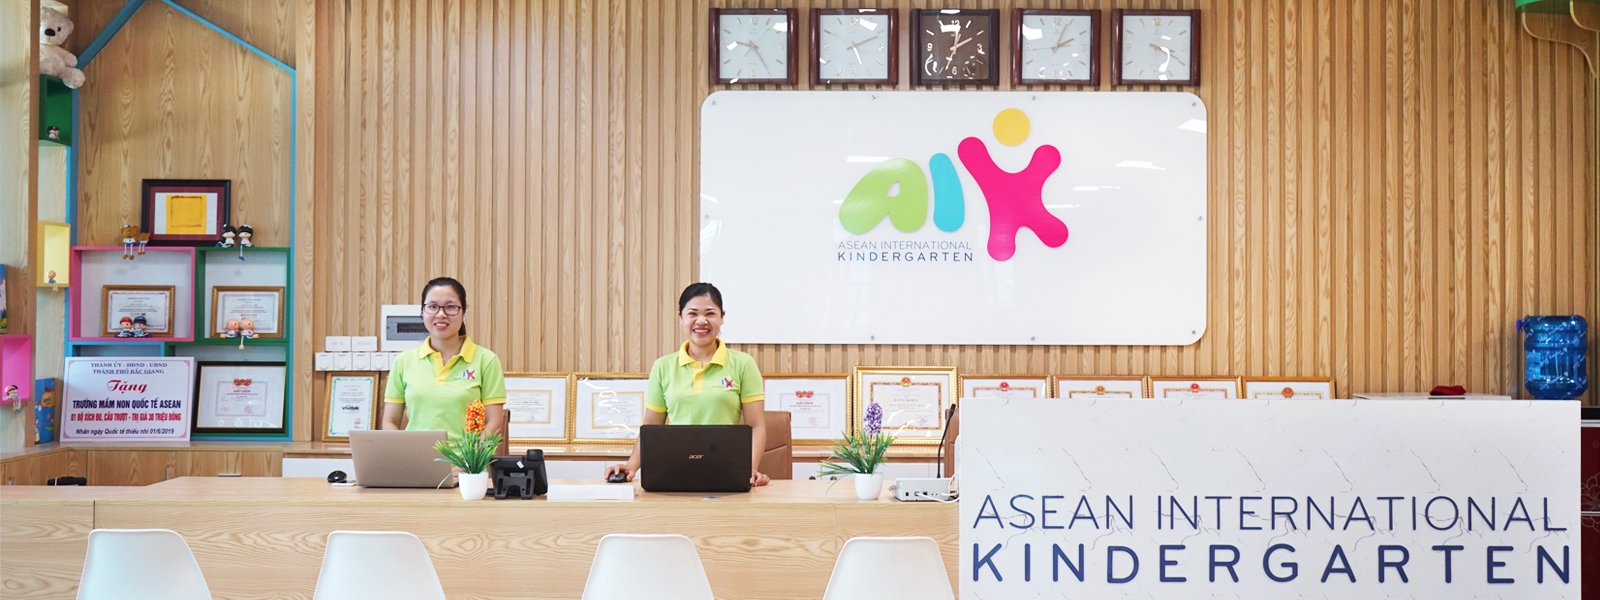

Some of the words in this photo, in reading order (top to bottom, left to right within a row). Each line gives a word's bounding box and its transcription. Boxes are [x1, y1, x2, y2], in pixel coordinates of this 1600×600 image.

[838, 241, 877, 250] ASEAN
[880, 241, 972, 250] INTERNATIONAL
[838, 252, 973, 262] KINDERGARTEN
[106, 380, 148, 394] Tặng
[116, 400, 130, 409] NON
[132, 397, 149, 410] QUỐC
[160, 400, 182, 409] ASEAN
[973, 494, 1133, 530] ASEAN
[1158, 495, 1567, 532] INTERNATIONAL
[972, 543, 1570, 584] KINDERGARTEN
